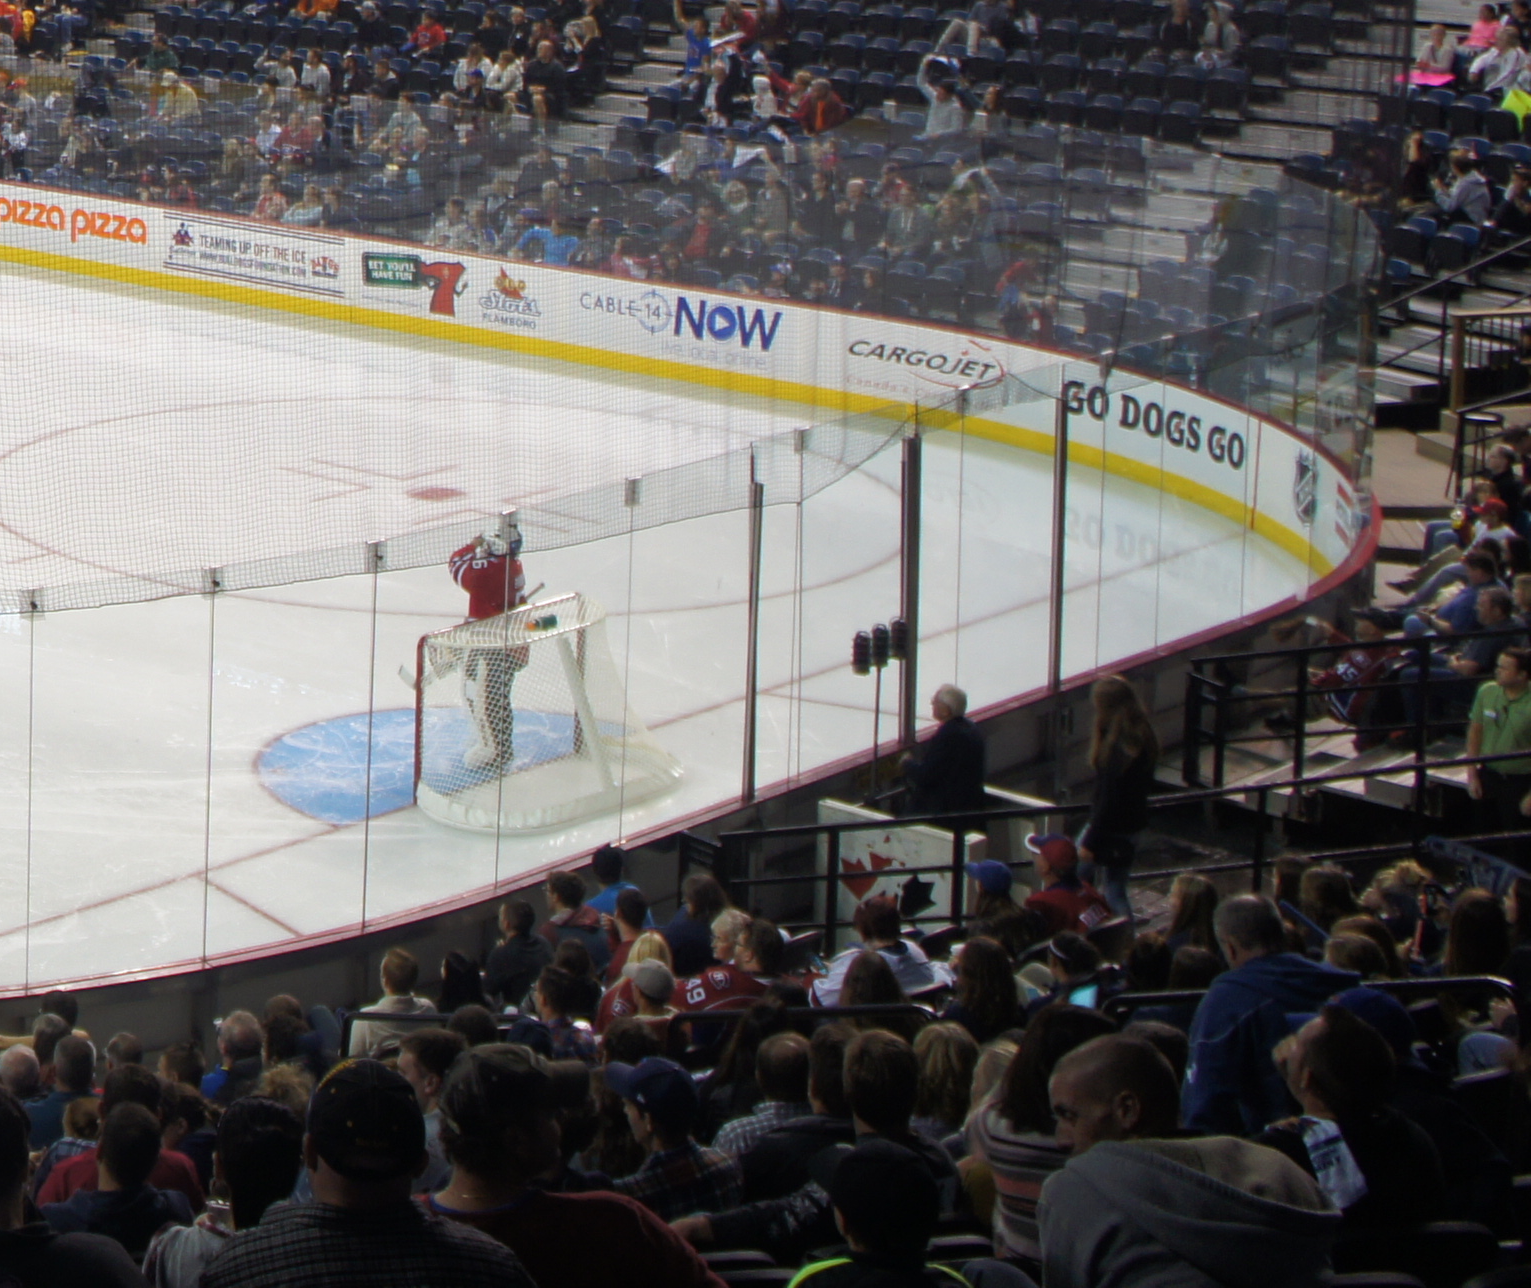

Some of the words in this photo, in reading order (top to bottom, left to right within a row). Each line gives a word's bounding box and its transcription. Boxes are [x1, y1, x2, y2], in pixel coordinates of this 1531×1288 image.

[71, 207, 148, 244] pizza
[200, 234, 237, 253] TEAMING
[239, 241, 252, 255] UP
[253, 243, 270, 259] OFF
[273, 247, 289, 262] THE
[292, 250, 307, 265] ICE
[371, 269, 393, 281] HAVE
[395, 270, 413, 281] FUN
[580, 292, 637, 316] CABLE
[645, 303, 661, 319] 14
[848, 340, 997, 380] CARGOJET
[1064, 380, 1109, 421] GO
[1119, 393, 1201, 453] DOGS
[1207, 424, 1245, 470] GO
